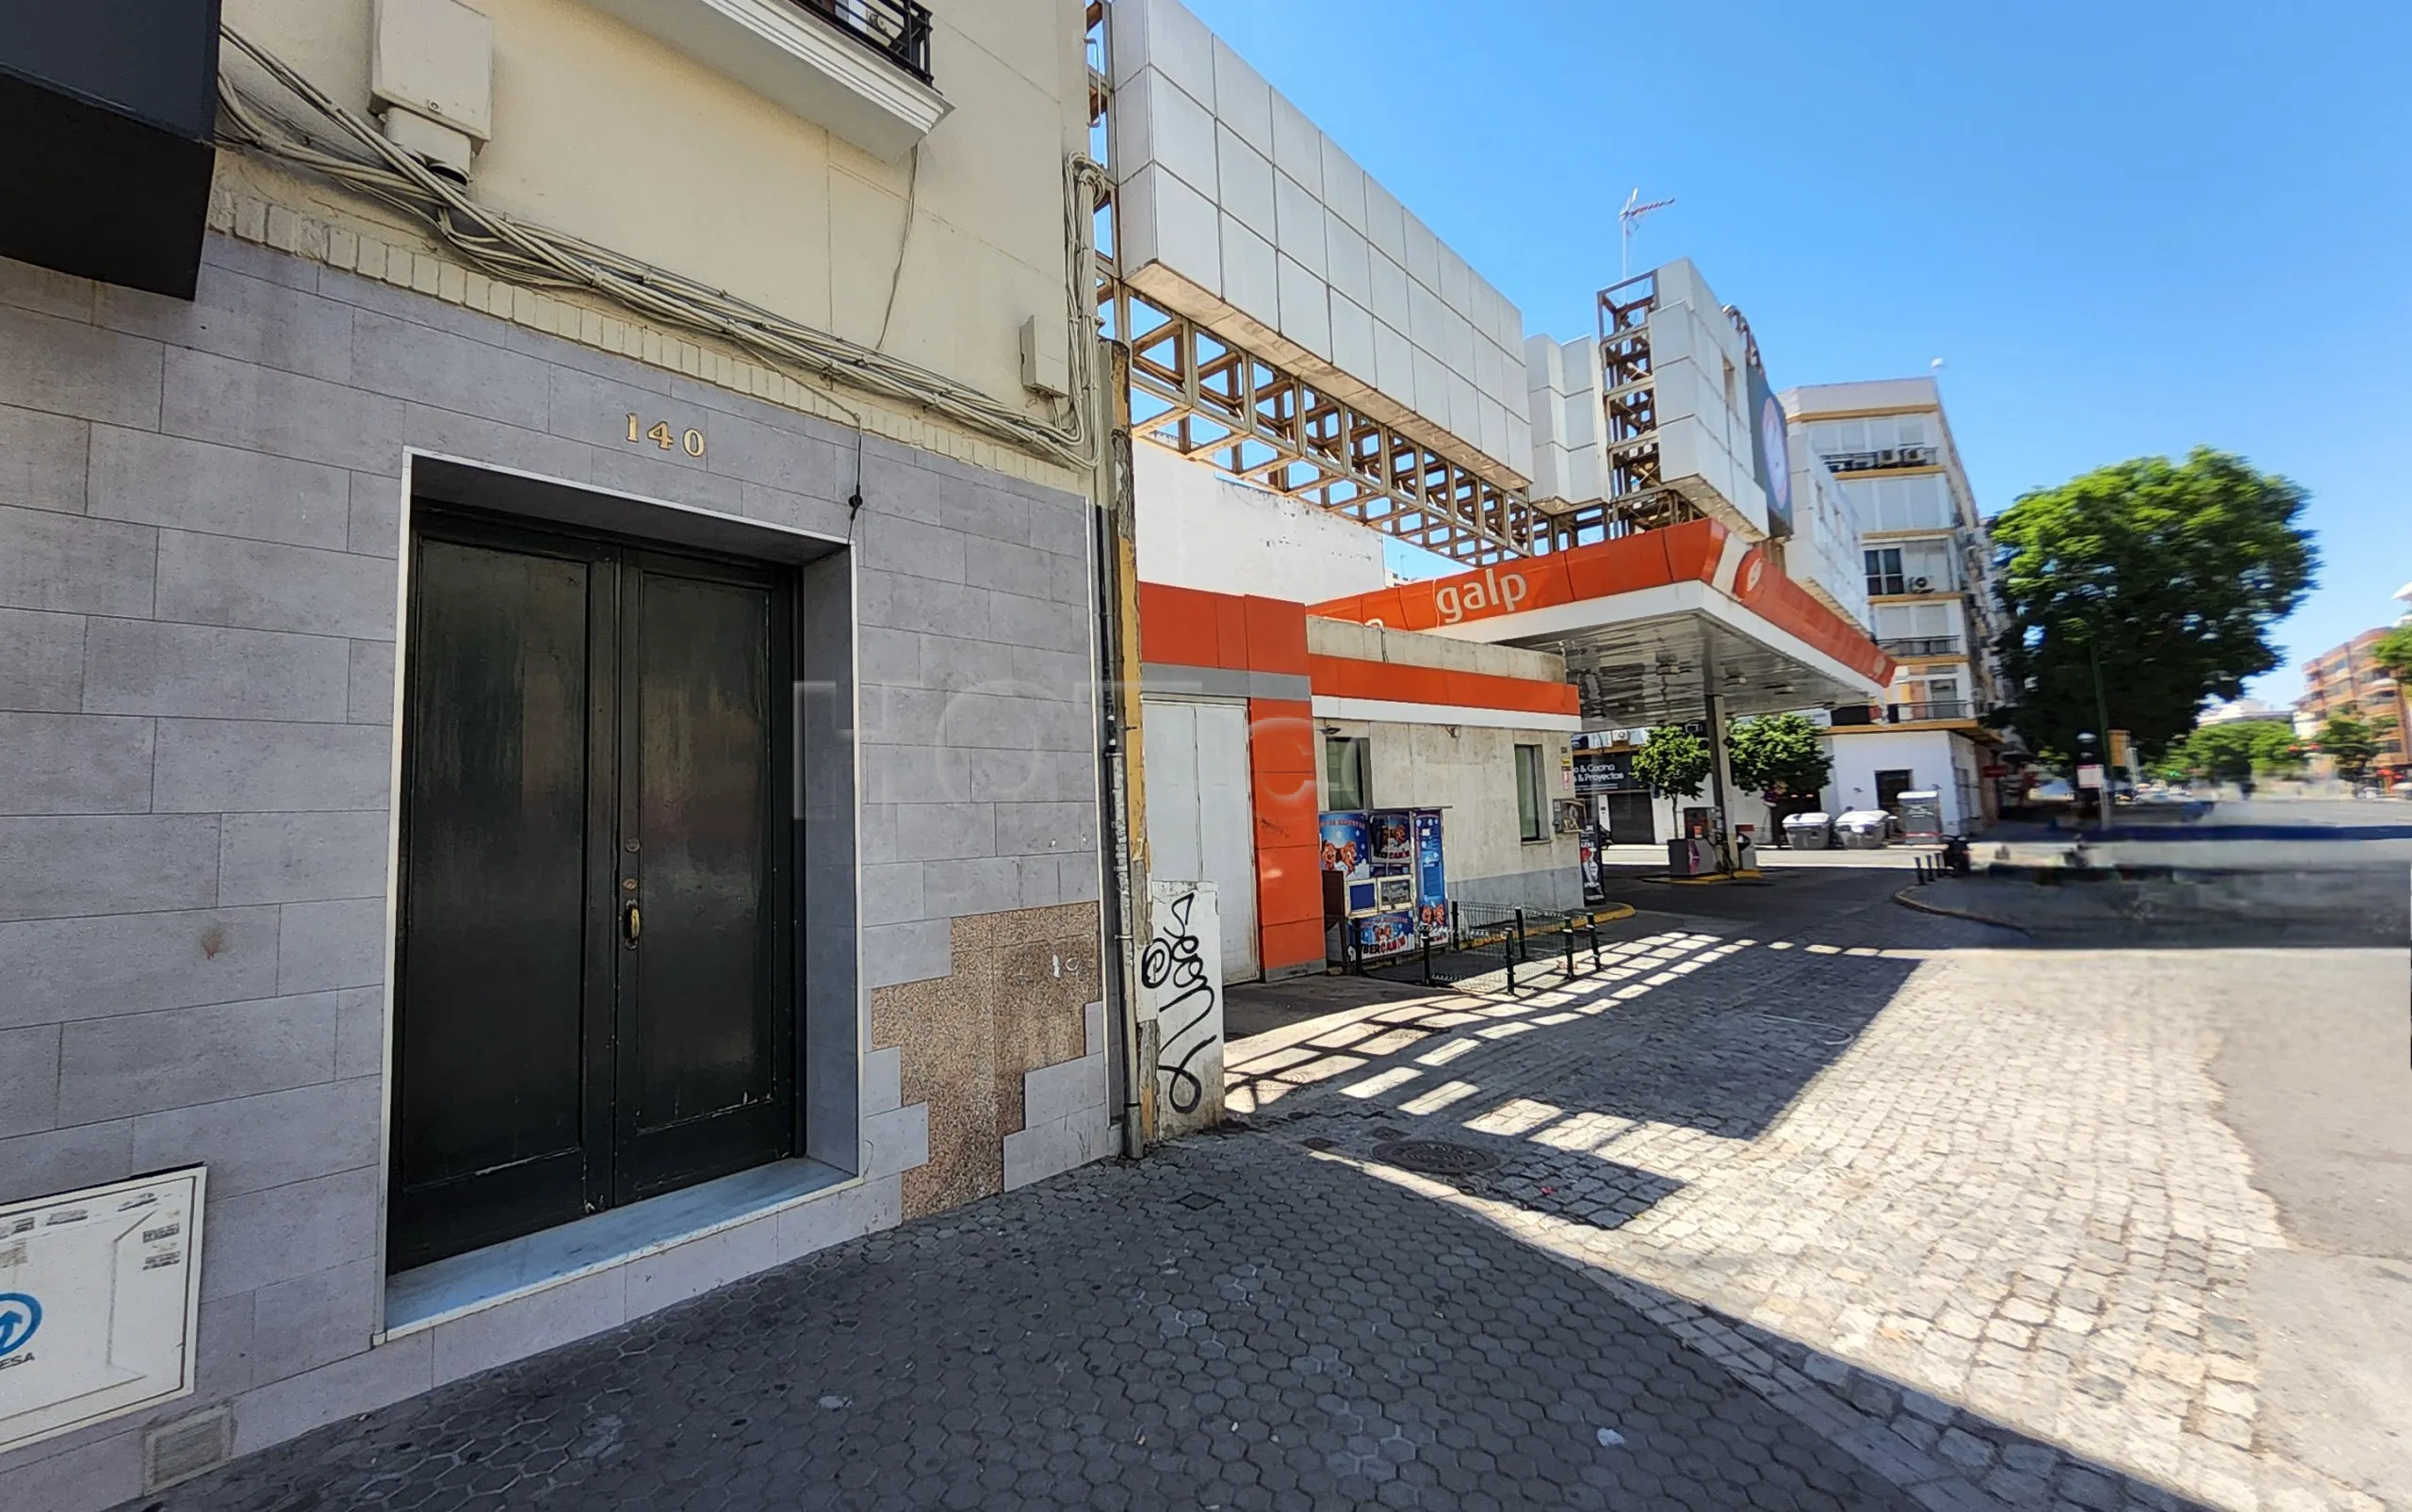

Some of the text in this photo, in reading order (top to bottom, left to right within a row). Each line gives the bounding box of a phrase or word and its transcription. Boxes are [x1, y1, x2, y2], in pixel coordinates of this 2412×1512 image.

[626, 413, 706, 457] 140
[1436, 568, 1526, 624] galp
[1585, 772, 1624, 783] Proyectos
[1587, 764, 1616, 772] Cocina
